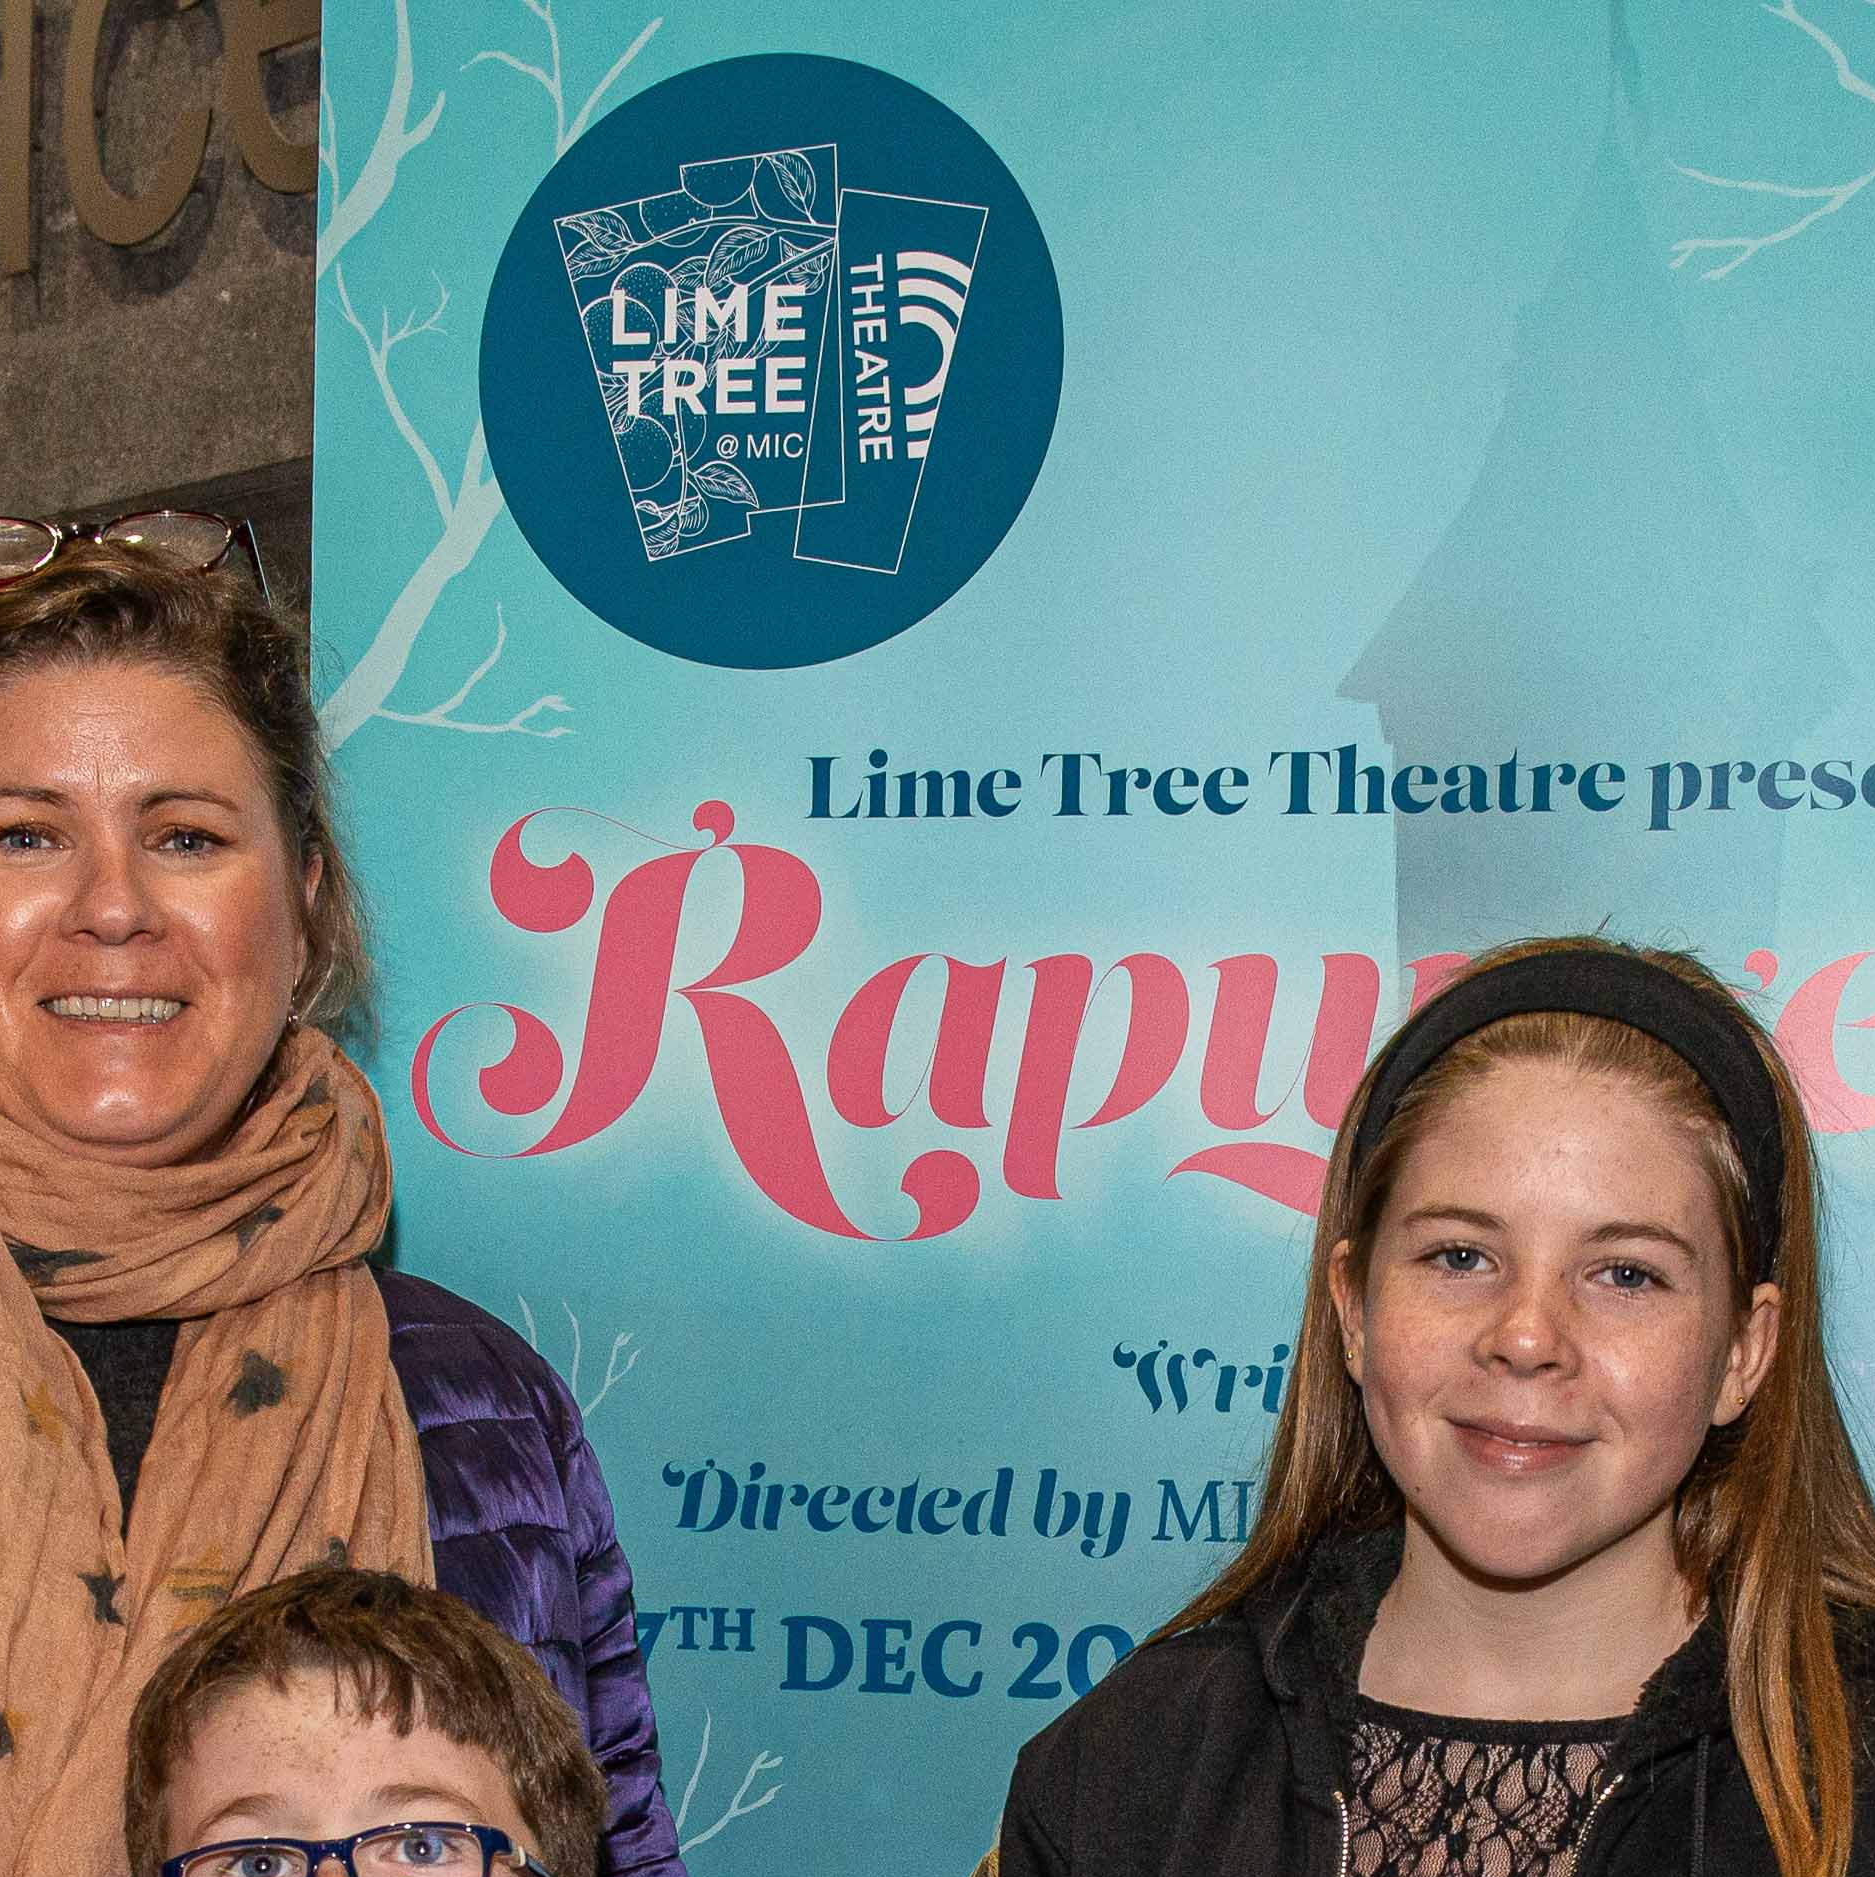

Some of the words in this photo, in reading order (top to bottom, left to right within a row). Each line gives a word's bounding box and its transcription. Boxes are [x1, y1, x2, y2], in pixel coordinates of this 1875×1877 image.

[612, 285, 807, 345] LIME
[612, 357, 807, 416] TREE
[850, 253, 894, 463] THEATRE
[809, 748, 1022, 819] Lime
[1041, 752, 1249, 817] Tree
[1269, 743, 1626, 815] Theatre
[662, 1458, 1014, 1537] Directed
[1033, 1468, 1131, 1559] by
[778, 1614, 984, 1699] DEC
[1007, 1622, 1159, 1701] 20
